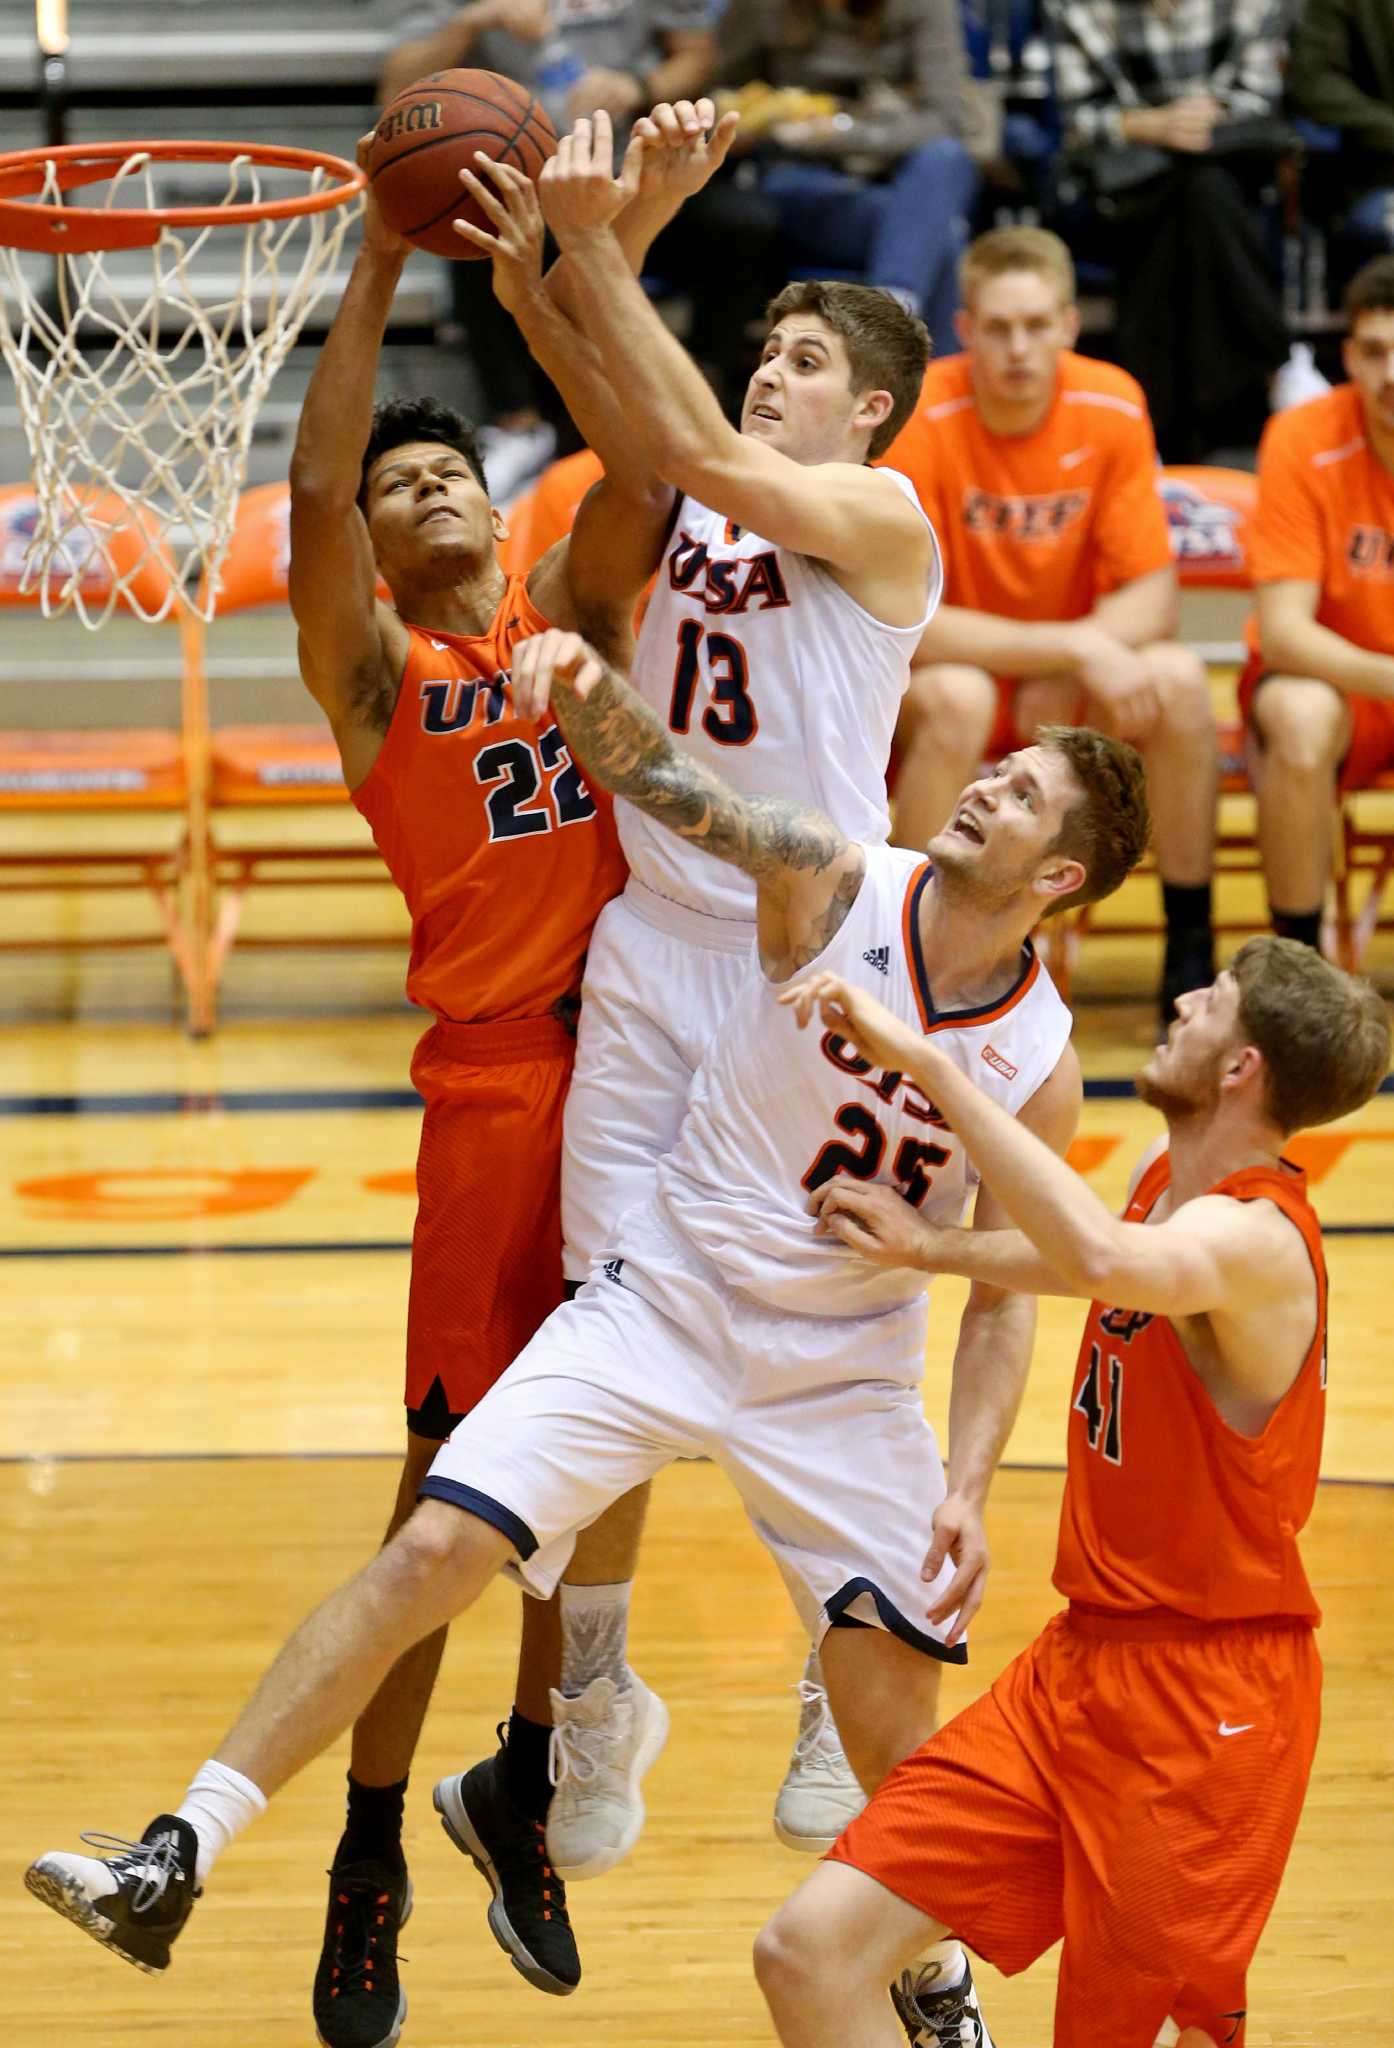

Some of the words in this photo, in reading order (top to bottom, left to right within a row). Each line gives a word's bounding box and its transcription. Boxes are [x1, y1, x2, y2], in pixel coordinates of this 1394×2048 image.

[668, 617, 759, 746] 13
[472, 723, 597, 844] 22
[800, 1102, 953, 1208] 25
[1073, 1341, 1123, 1467] 41
